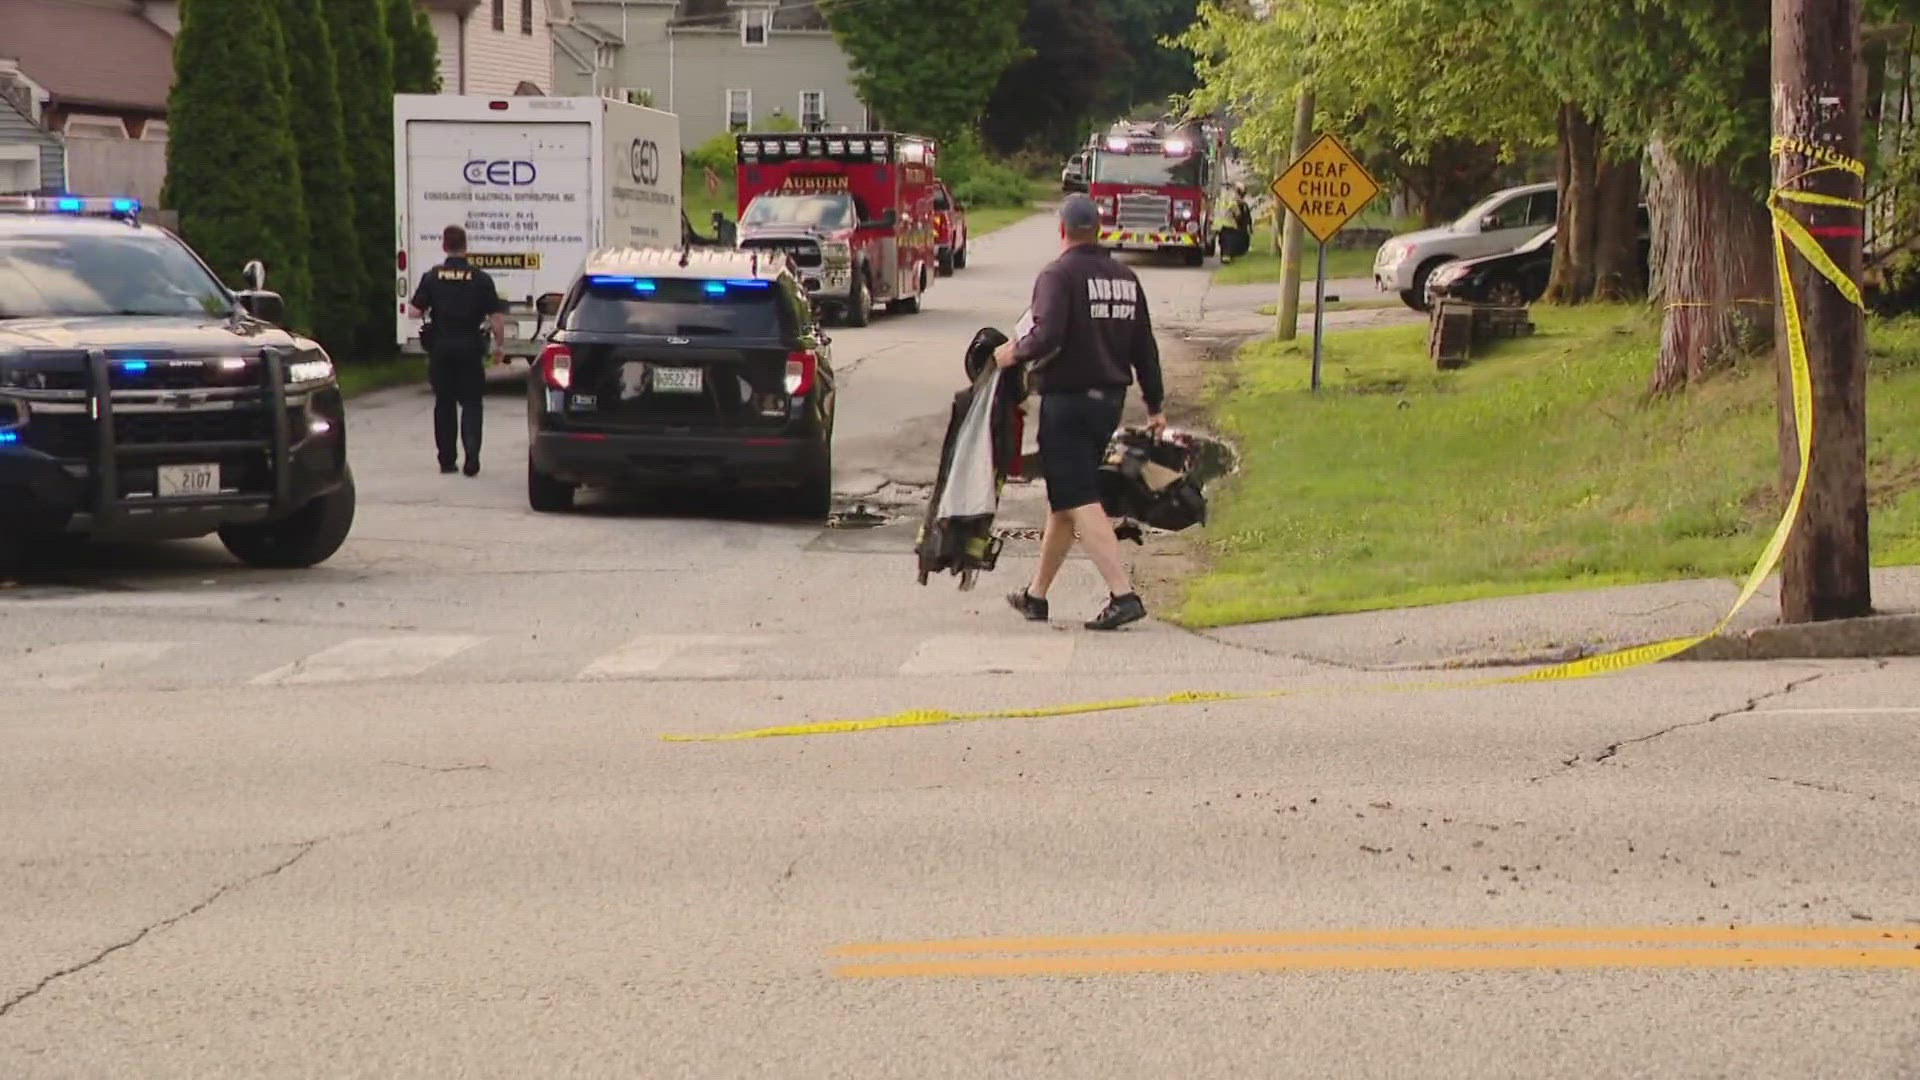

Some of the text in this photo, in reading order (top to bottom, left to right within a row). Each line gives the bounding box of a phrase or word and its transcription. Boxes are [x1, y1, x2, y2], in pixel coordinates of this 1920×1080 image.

[463, 160, 536, 185] CED
[1302, 161, 1349, 177] DEAF
[783, 176, 848, 189] AUBURN
[1298, 181, 1351, 197] CHILD
[1299, 200, 1348, 216] AREA
[1087, 278, 1137, 302] AUBURN
[182, 472, 212, 489] 2107
